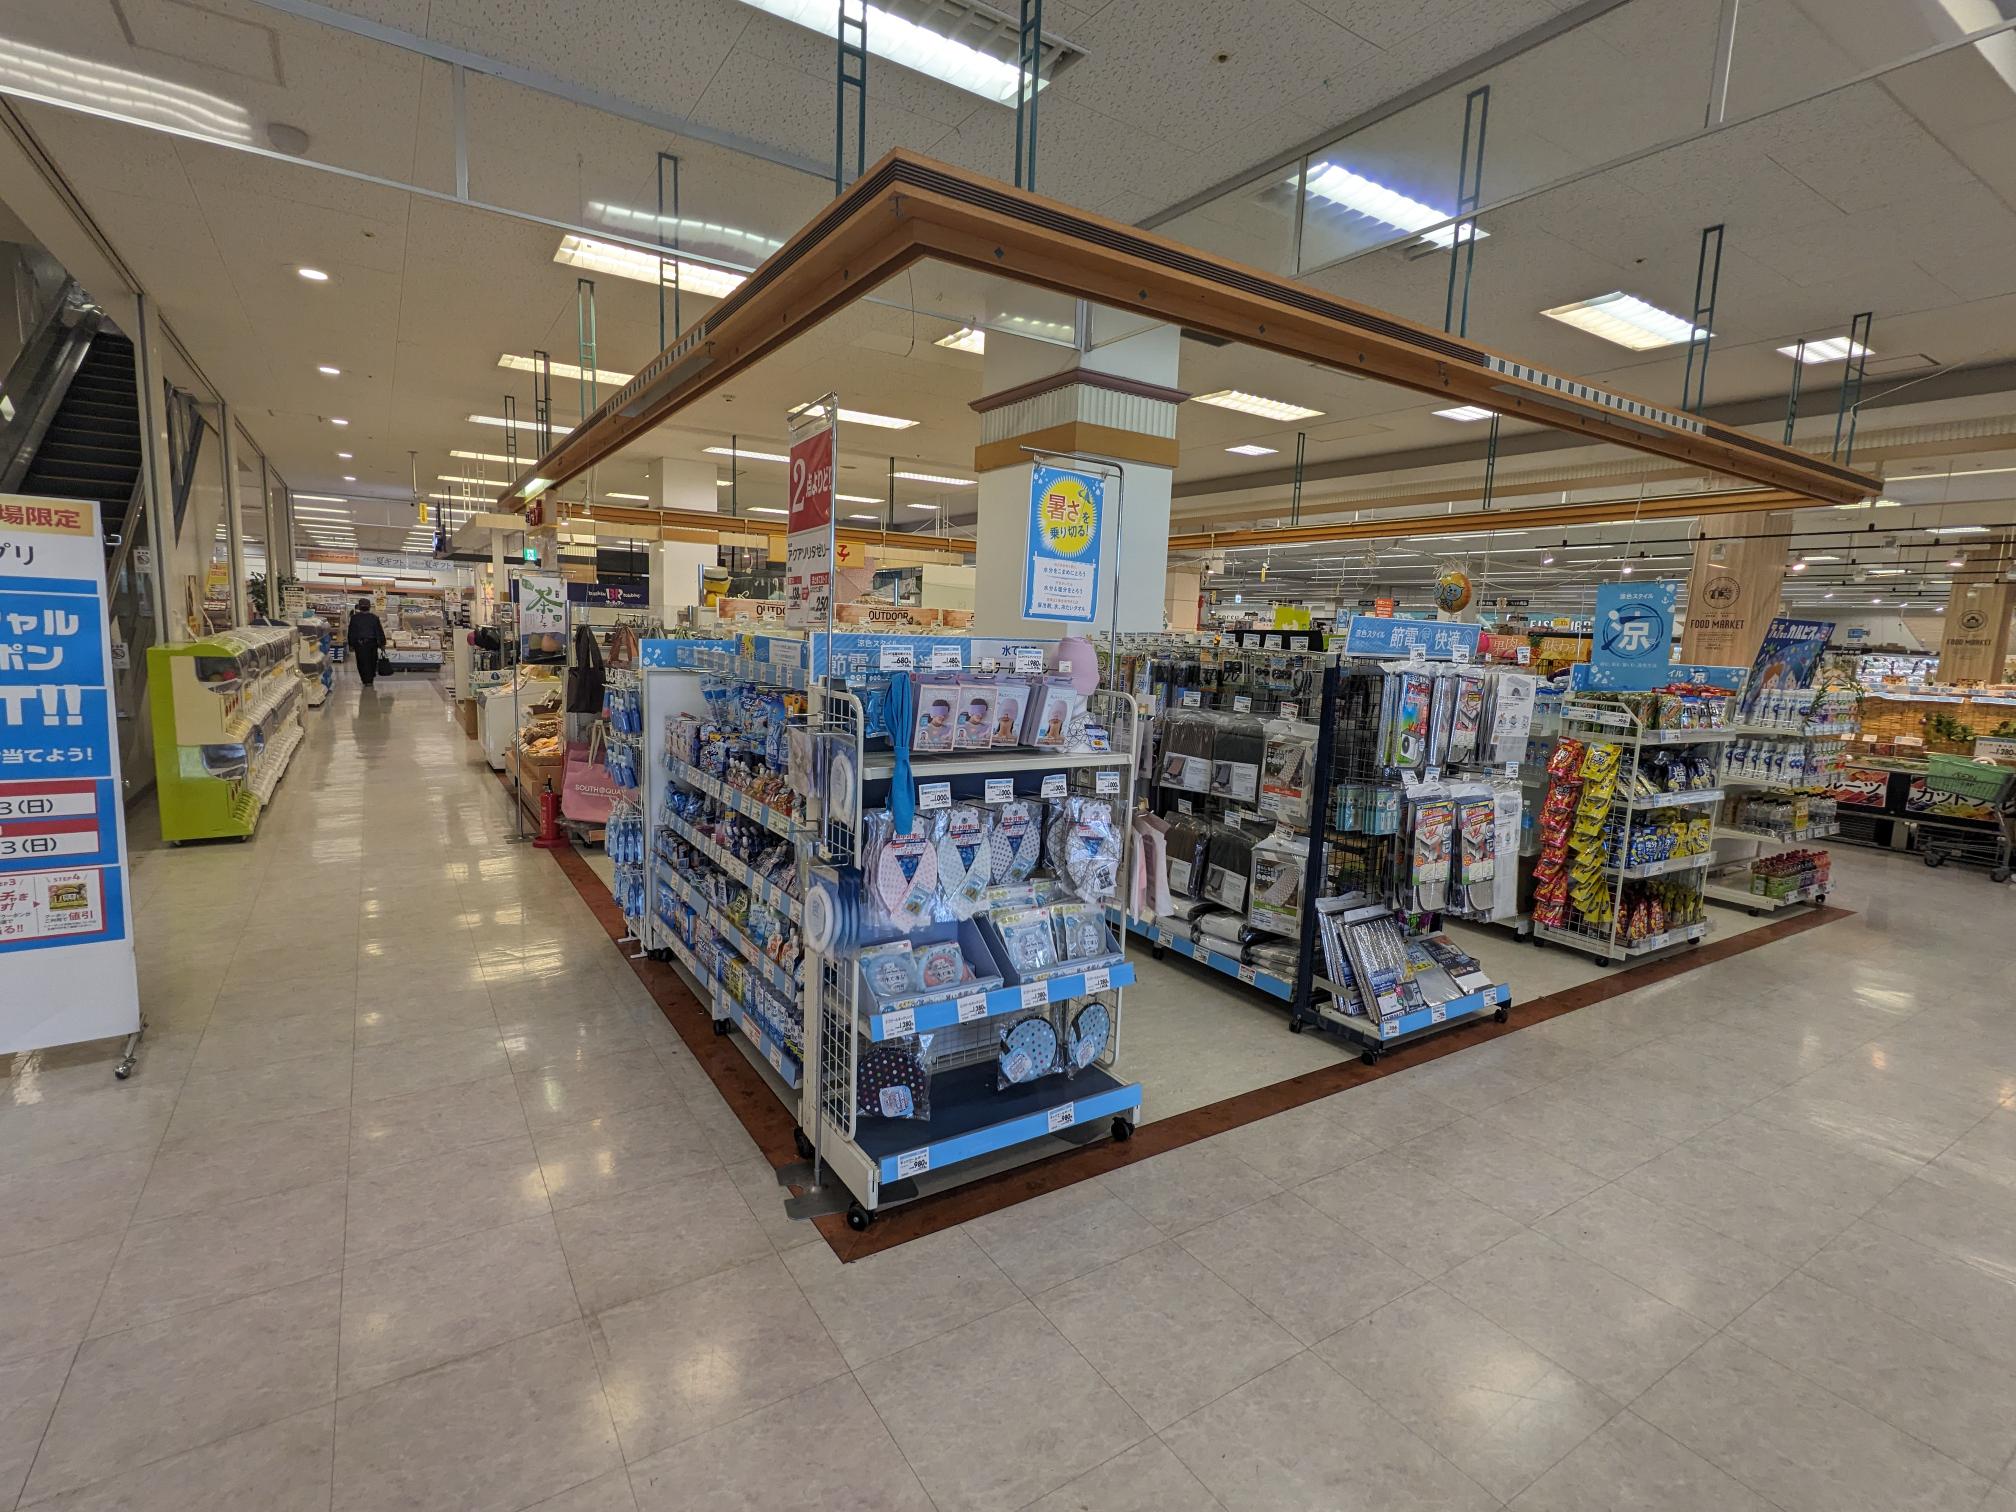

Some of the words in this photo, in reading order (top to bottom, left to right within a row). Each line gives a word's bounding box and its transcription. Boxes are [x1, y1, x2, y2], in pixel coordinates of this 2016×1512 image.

[1050, 525, 1089, 540] 乗り切る!
[1690, 620, 1710, 629] FOOD
[1711, 619, 1744, 630] MARKET
[575, 784, 599, 793] SOUTH
[1, 838, 57, 855] 3(日)
